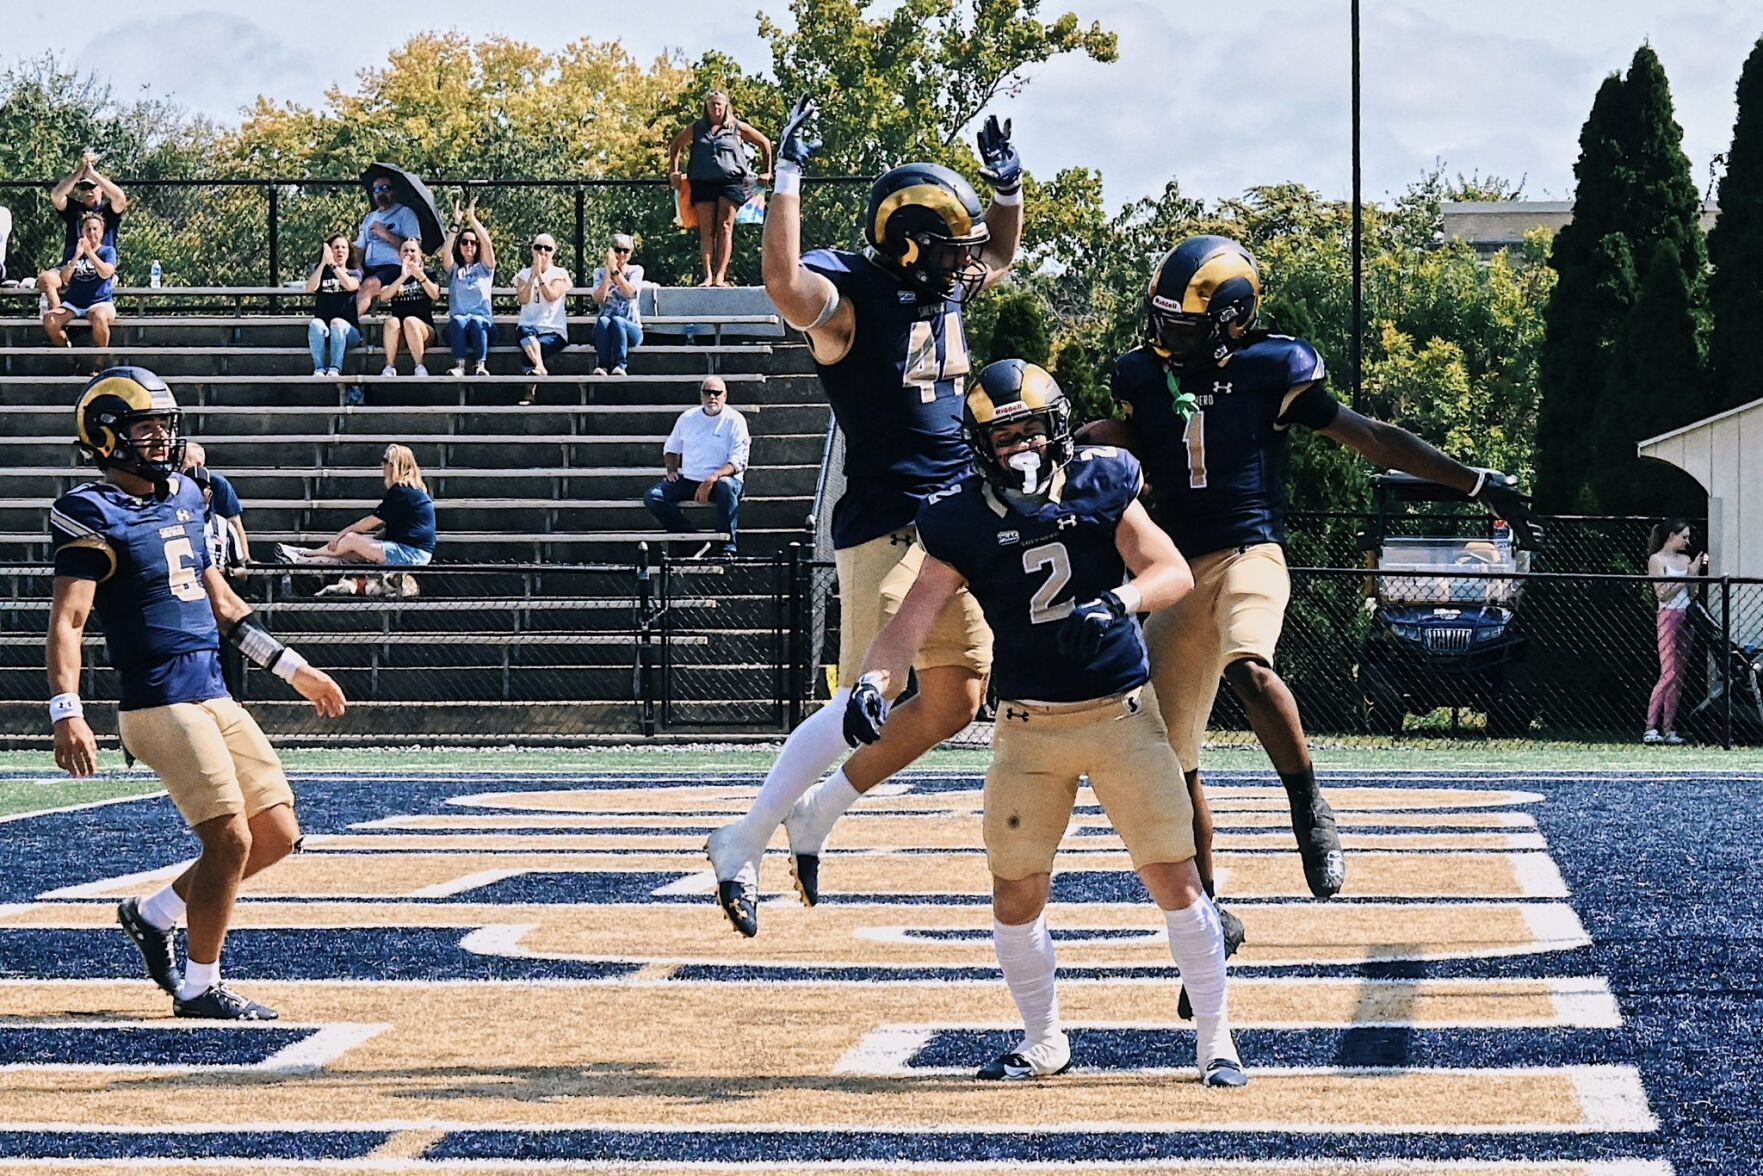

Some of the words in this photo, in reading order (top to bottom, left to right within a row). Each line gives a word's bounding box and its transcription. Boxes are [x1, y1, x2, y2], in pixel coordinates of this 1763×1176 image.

[902, 311, 970, 403] 44
[1182, 410, 1208, 488] 1
[1022, 541, 1076, 624] 2
